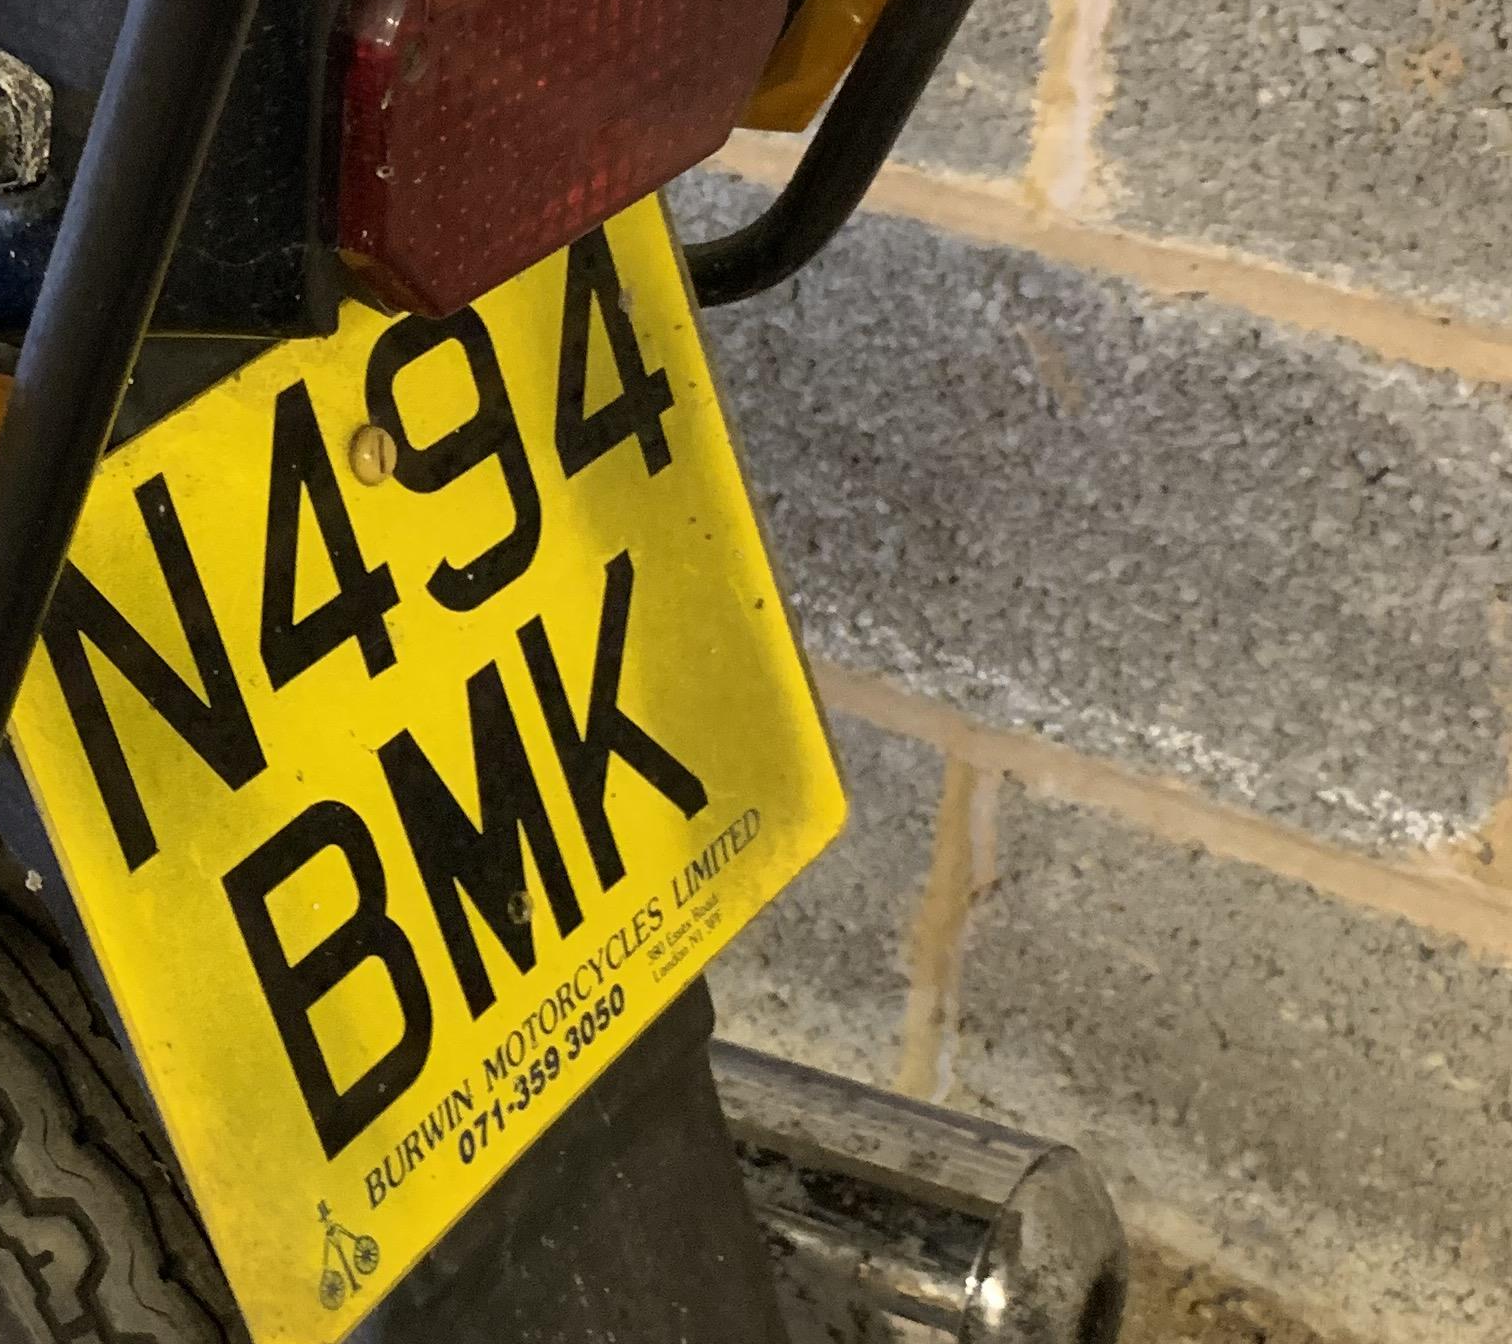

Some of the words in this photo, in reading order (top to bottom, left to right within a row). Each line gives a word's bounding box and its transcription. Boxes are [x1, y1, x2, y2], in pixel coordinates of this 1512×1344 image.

[41, 224, 674, 874] N494
[222, 550, 709, 1161] BMK
[364, 1079, 473, 1209] BURWIN
[483, 896, 663, 1093] MOTORCYCLES
[671, 808, 760, 909] LIMITED
[458, 1046, 560, 1165] 071-359
[565, 983, 625, 1060] 3050
